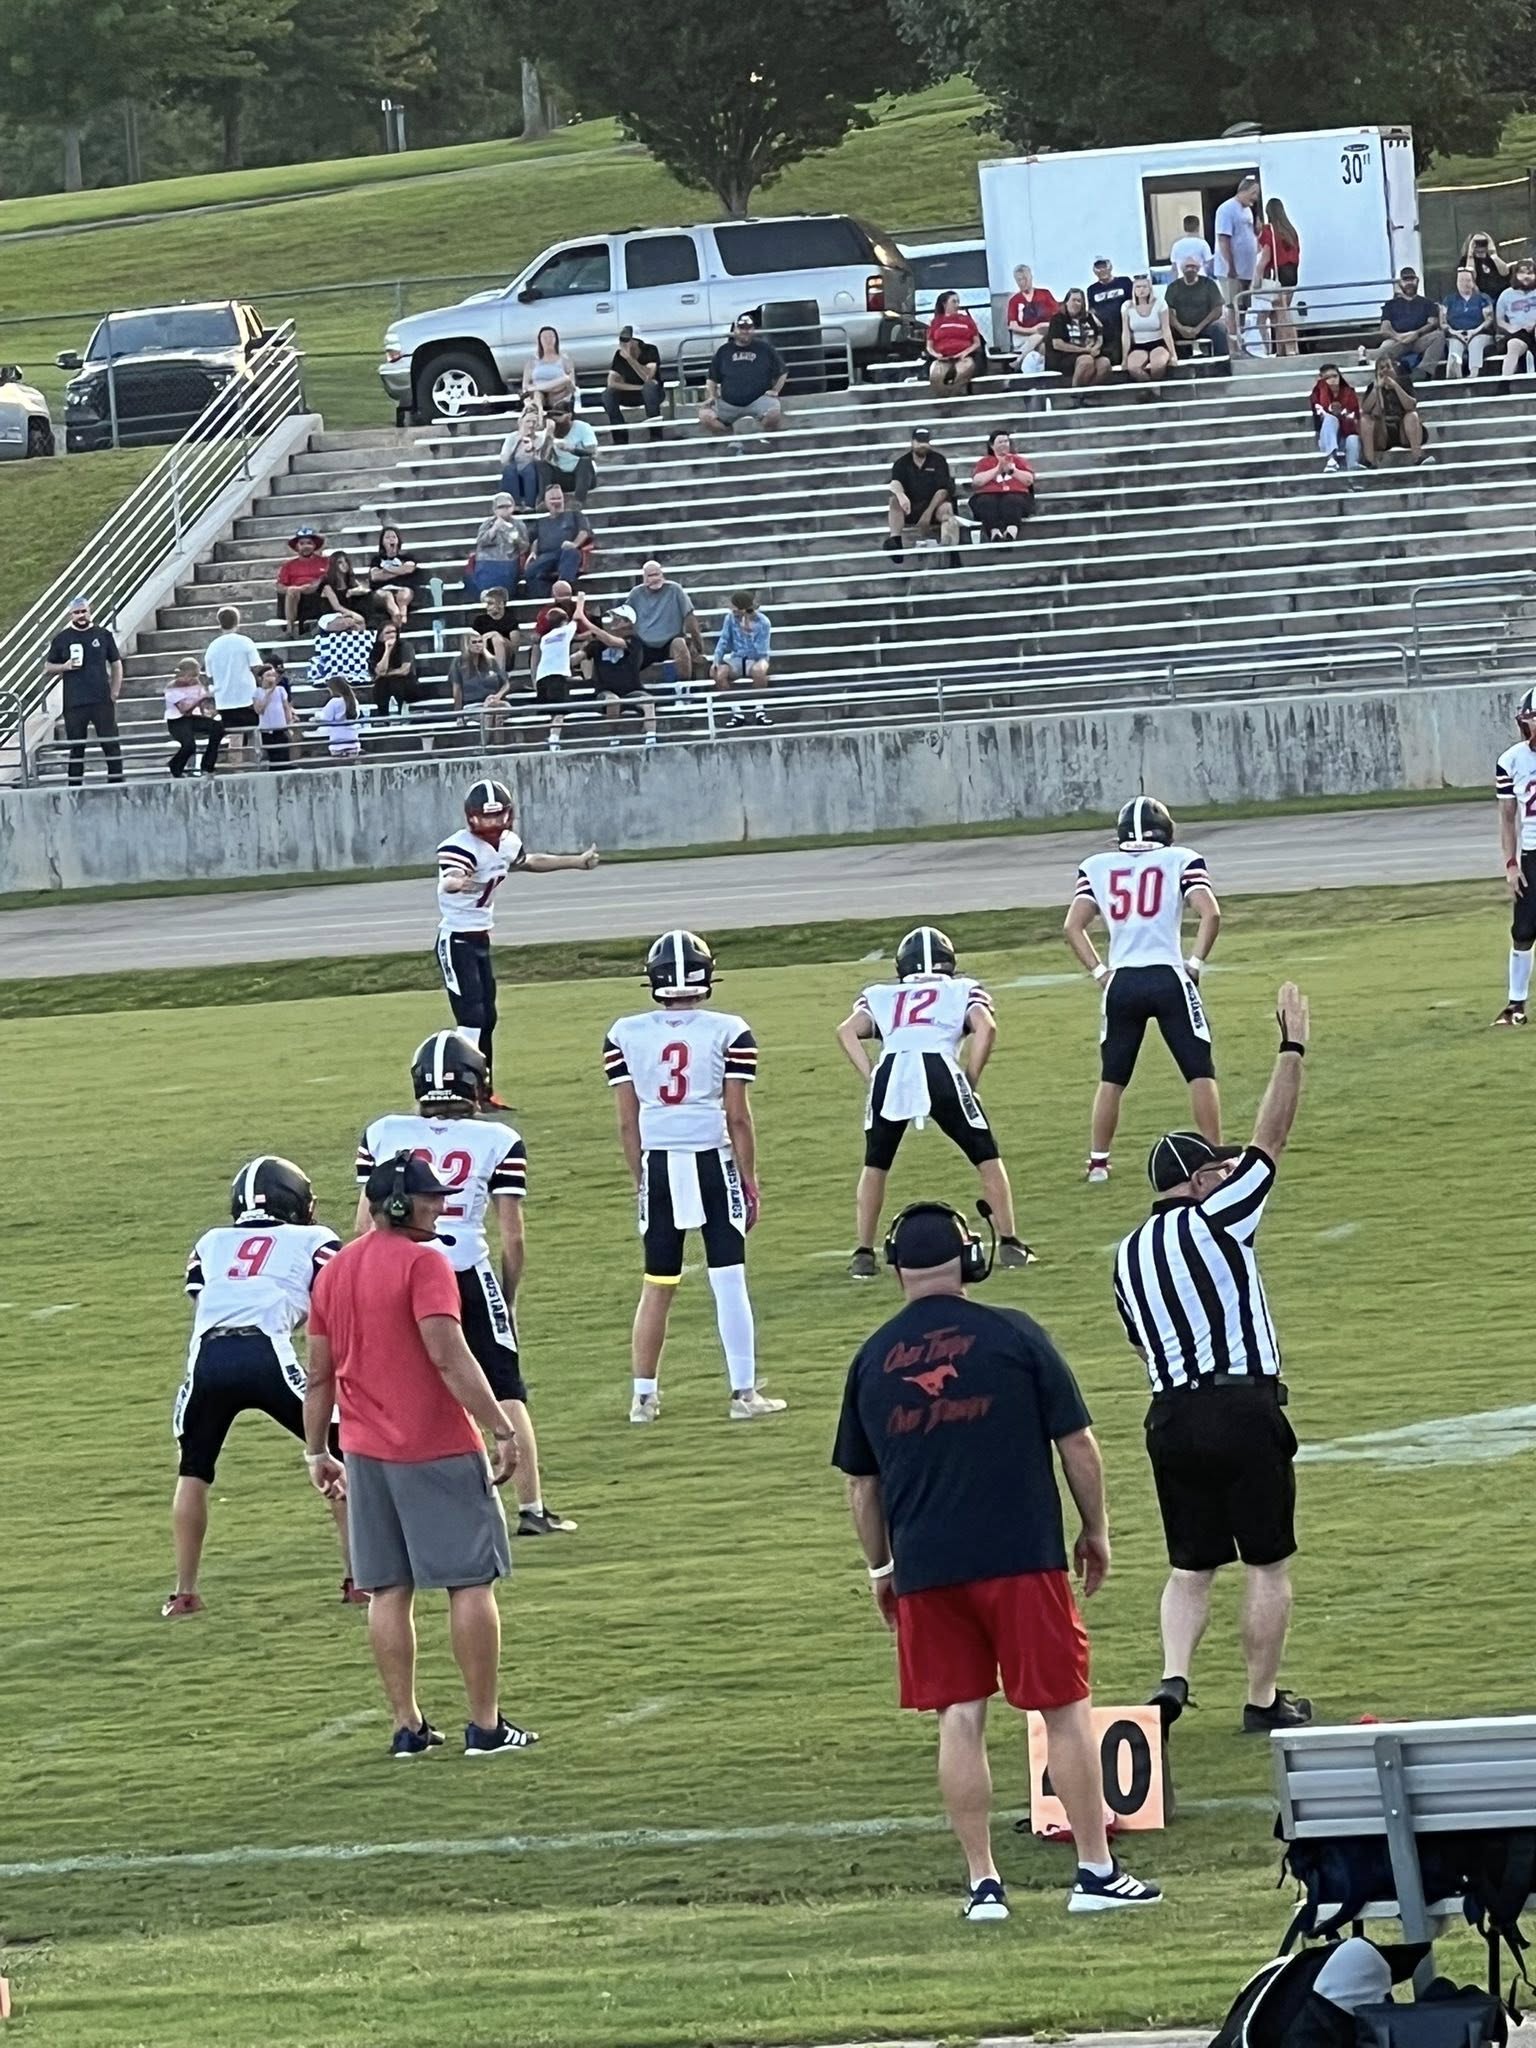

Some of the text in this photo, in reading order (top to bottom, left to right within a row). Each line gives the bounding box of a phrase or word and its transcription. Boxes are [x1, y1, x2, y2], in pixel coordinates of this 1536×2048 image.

[1109, 866, 1164, 921] 50
[893, 987, 940, 1030] 12
[657, 1039, 692, 1105] 3
[725, 1160, 743, 1219] MUSTANGS
[228, 1235, 277, 1280] 9
[483, 1272, 508, 1334] MUSTANGS
